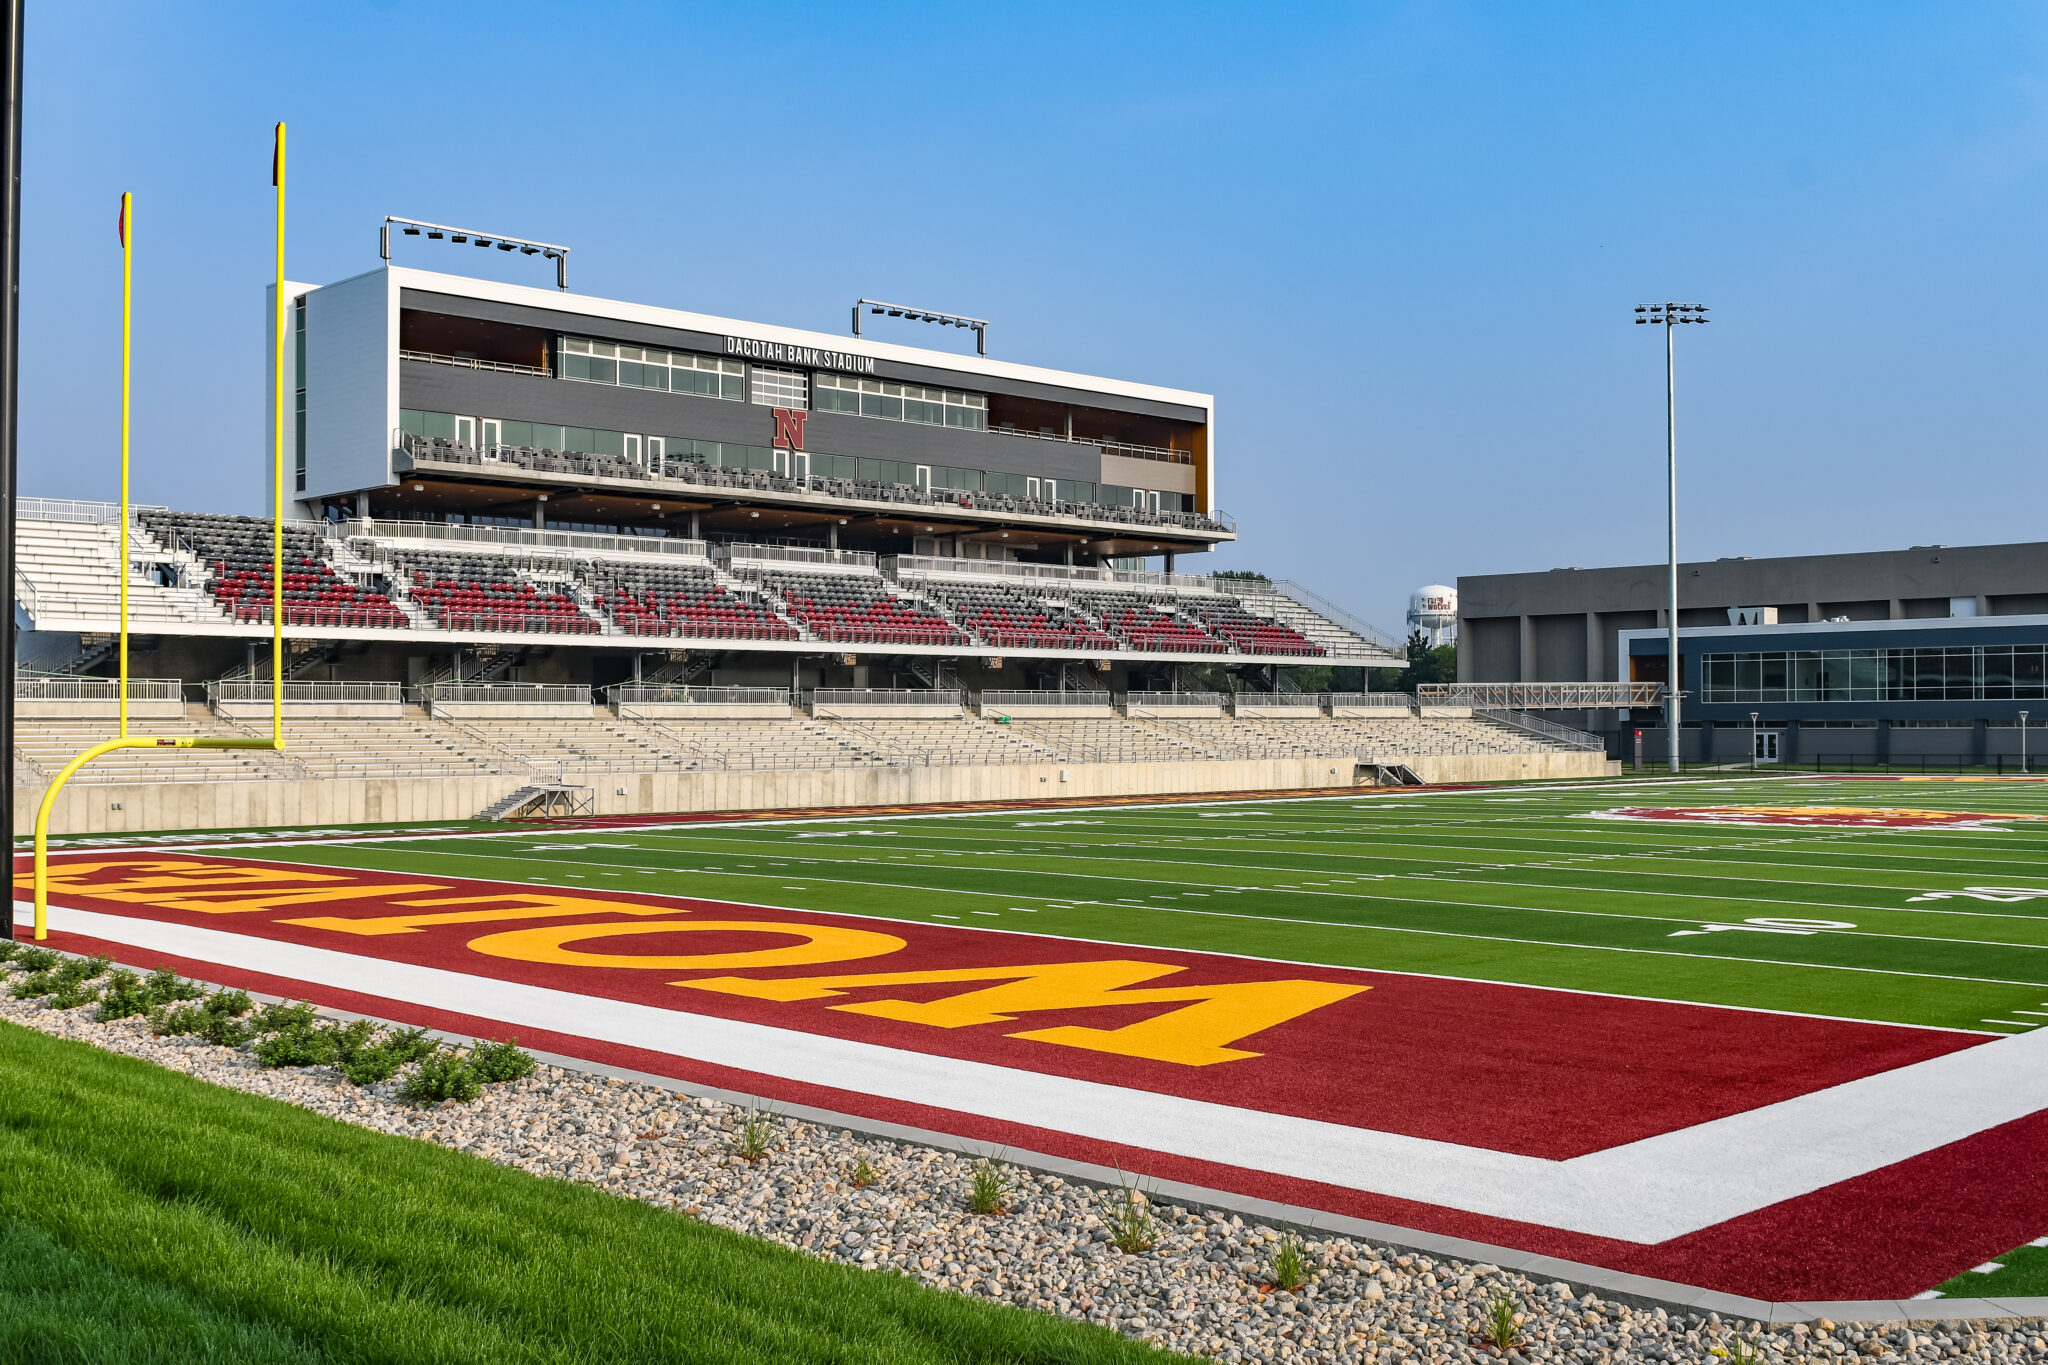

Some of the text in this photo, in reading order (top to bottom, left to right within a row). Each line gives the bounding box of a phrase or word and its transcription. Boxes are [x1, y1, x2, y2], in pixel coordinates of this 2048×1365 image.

[727, 336, 874, 374] DACOTAH BANK STADIUM
[773, 407, 808, 450] N
[1701, 917, 1857, 936] 10
